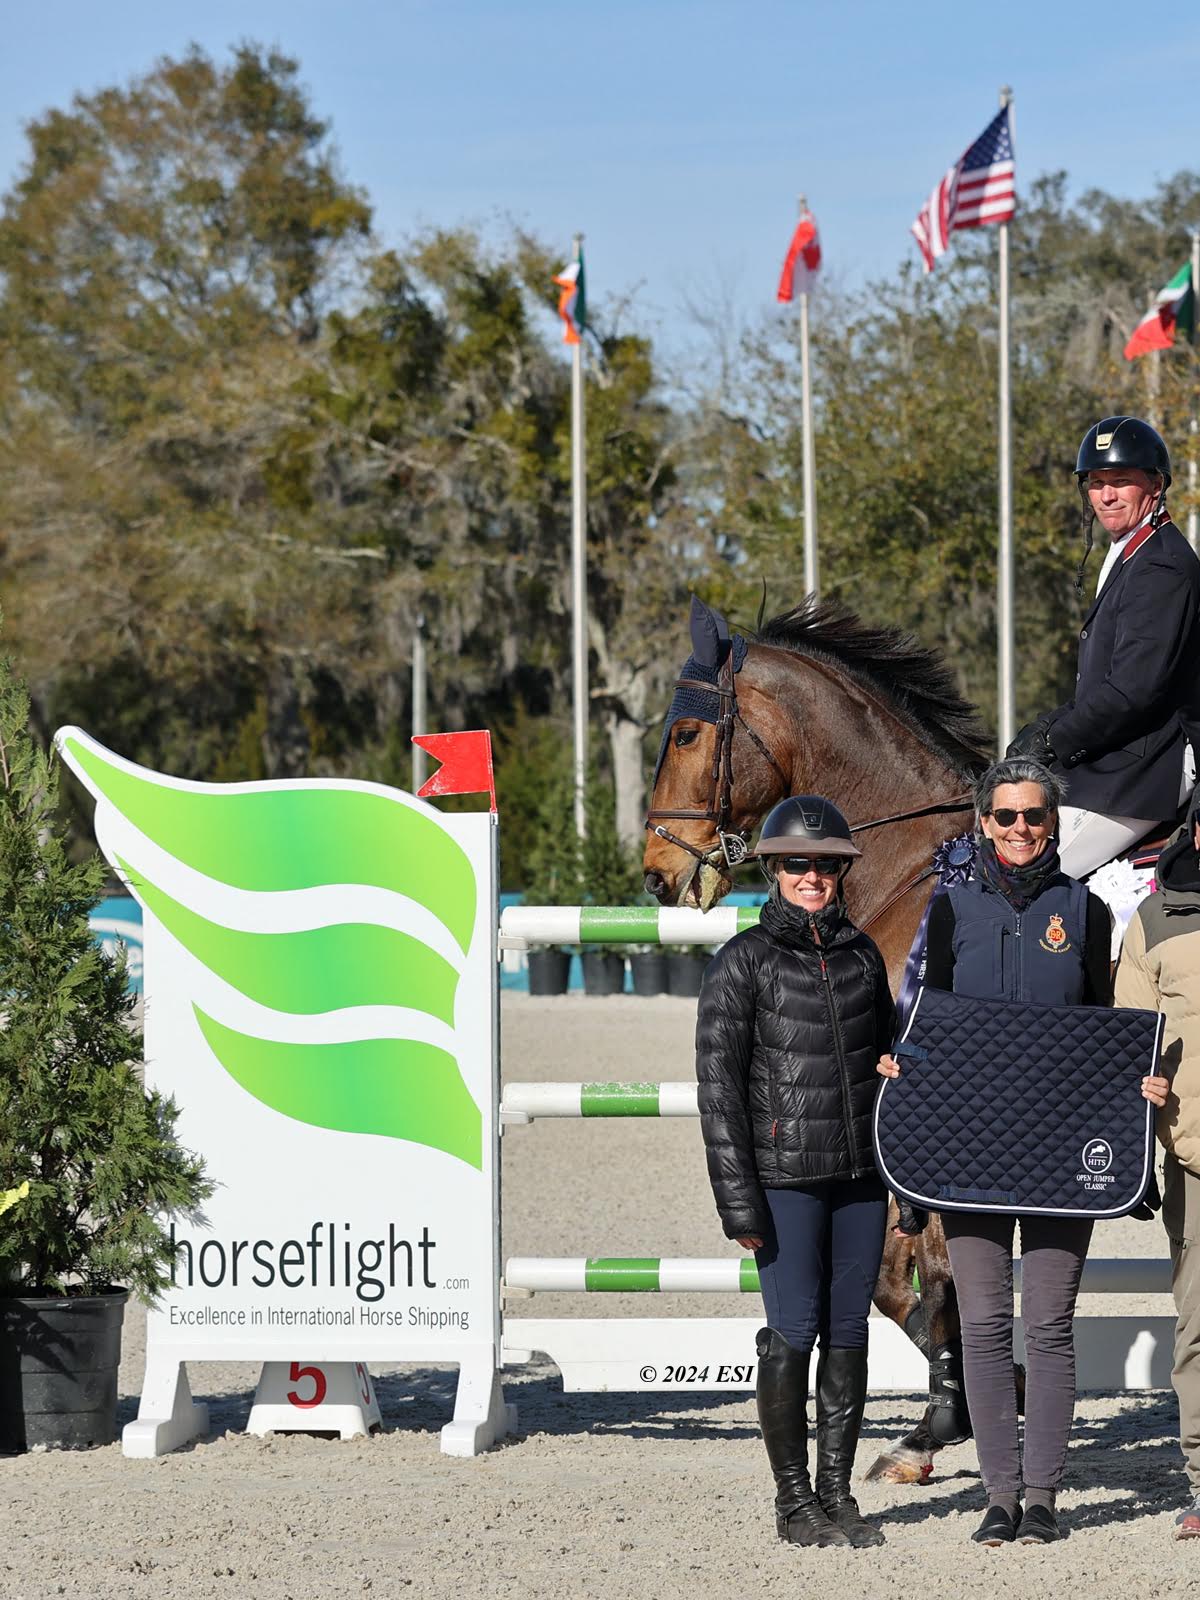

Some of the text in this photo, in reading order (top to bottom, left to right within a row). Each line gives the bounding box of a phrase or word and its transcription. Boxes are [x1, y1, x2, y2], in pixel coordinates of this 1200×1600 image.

[1076, 1174, 1116, 1183] OPEN JUMPER
[170, 1221, 470, 1303] horseflight .com
[170, 1305, 470, 1331] Excellence in International Horse Shipping
[287, 1361, 327, 1409] 5
